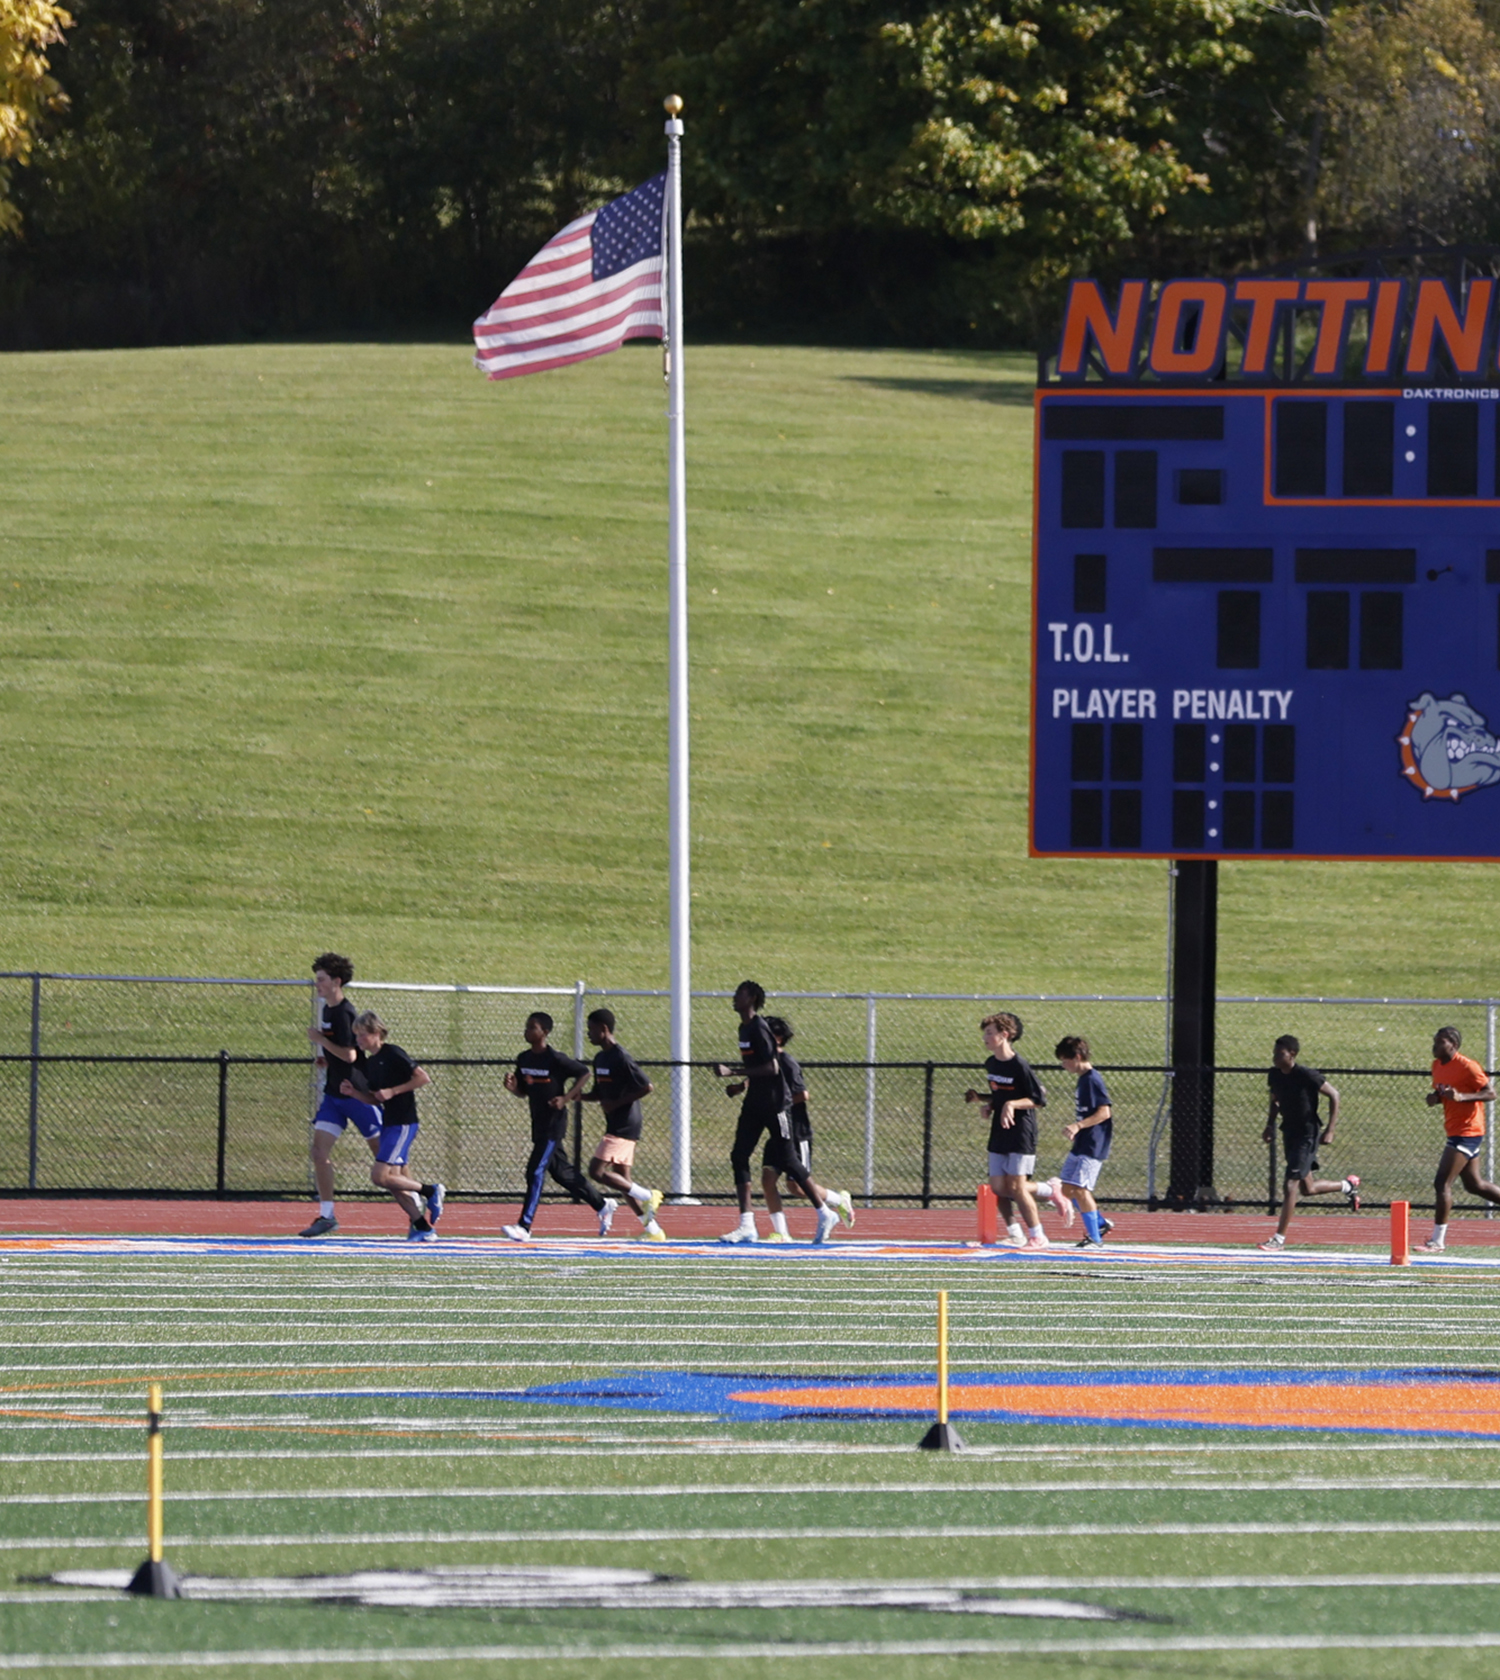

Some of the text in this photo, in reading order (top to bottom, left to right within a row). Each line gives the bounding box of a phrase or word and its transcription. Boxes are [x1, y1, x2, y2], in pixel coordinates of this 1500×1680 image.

[1403, 388, 1500, 399] DAKTRONICS
[1048, 622, 1129, 663] T.O.L.
[1053, 689, 1293, 720] PLAYER PENALTY
